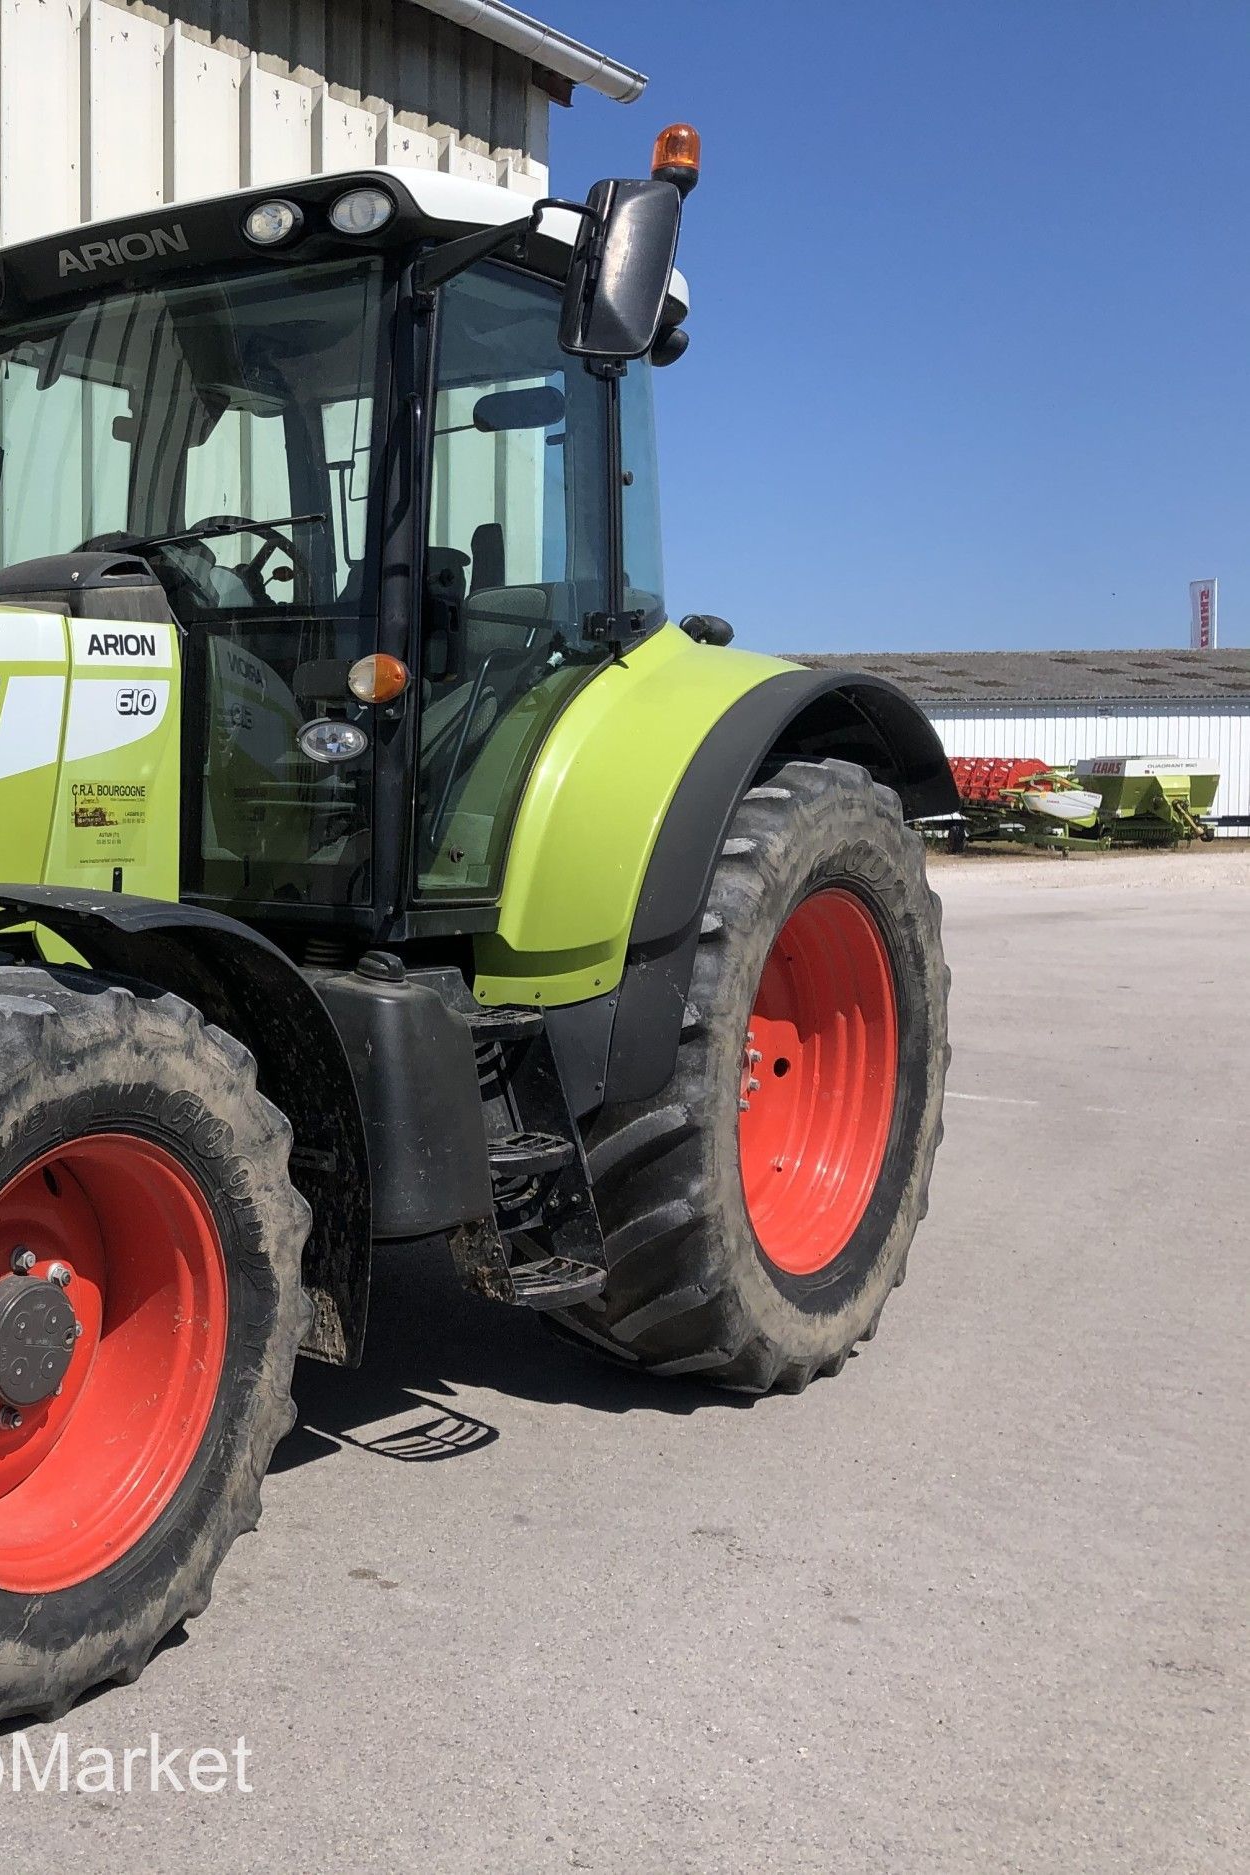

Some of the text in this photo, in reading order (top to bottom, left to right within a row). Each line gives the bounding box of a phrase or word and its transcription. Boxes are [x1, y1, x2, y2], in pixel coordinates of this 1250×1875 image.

[58, 224, 190, 278] ARION
[88, 634, 156, 657] ARION
[115, 688, 157, 716] 610
[1091, 761, 1123, 775] CLAAS
[71, 784, 146, 797] C.R.A. BOURGOGNE
